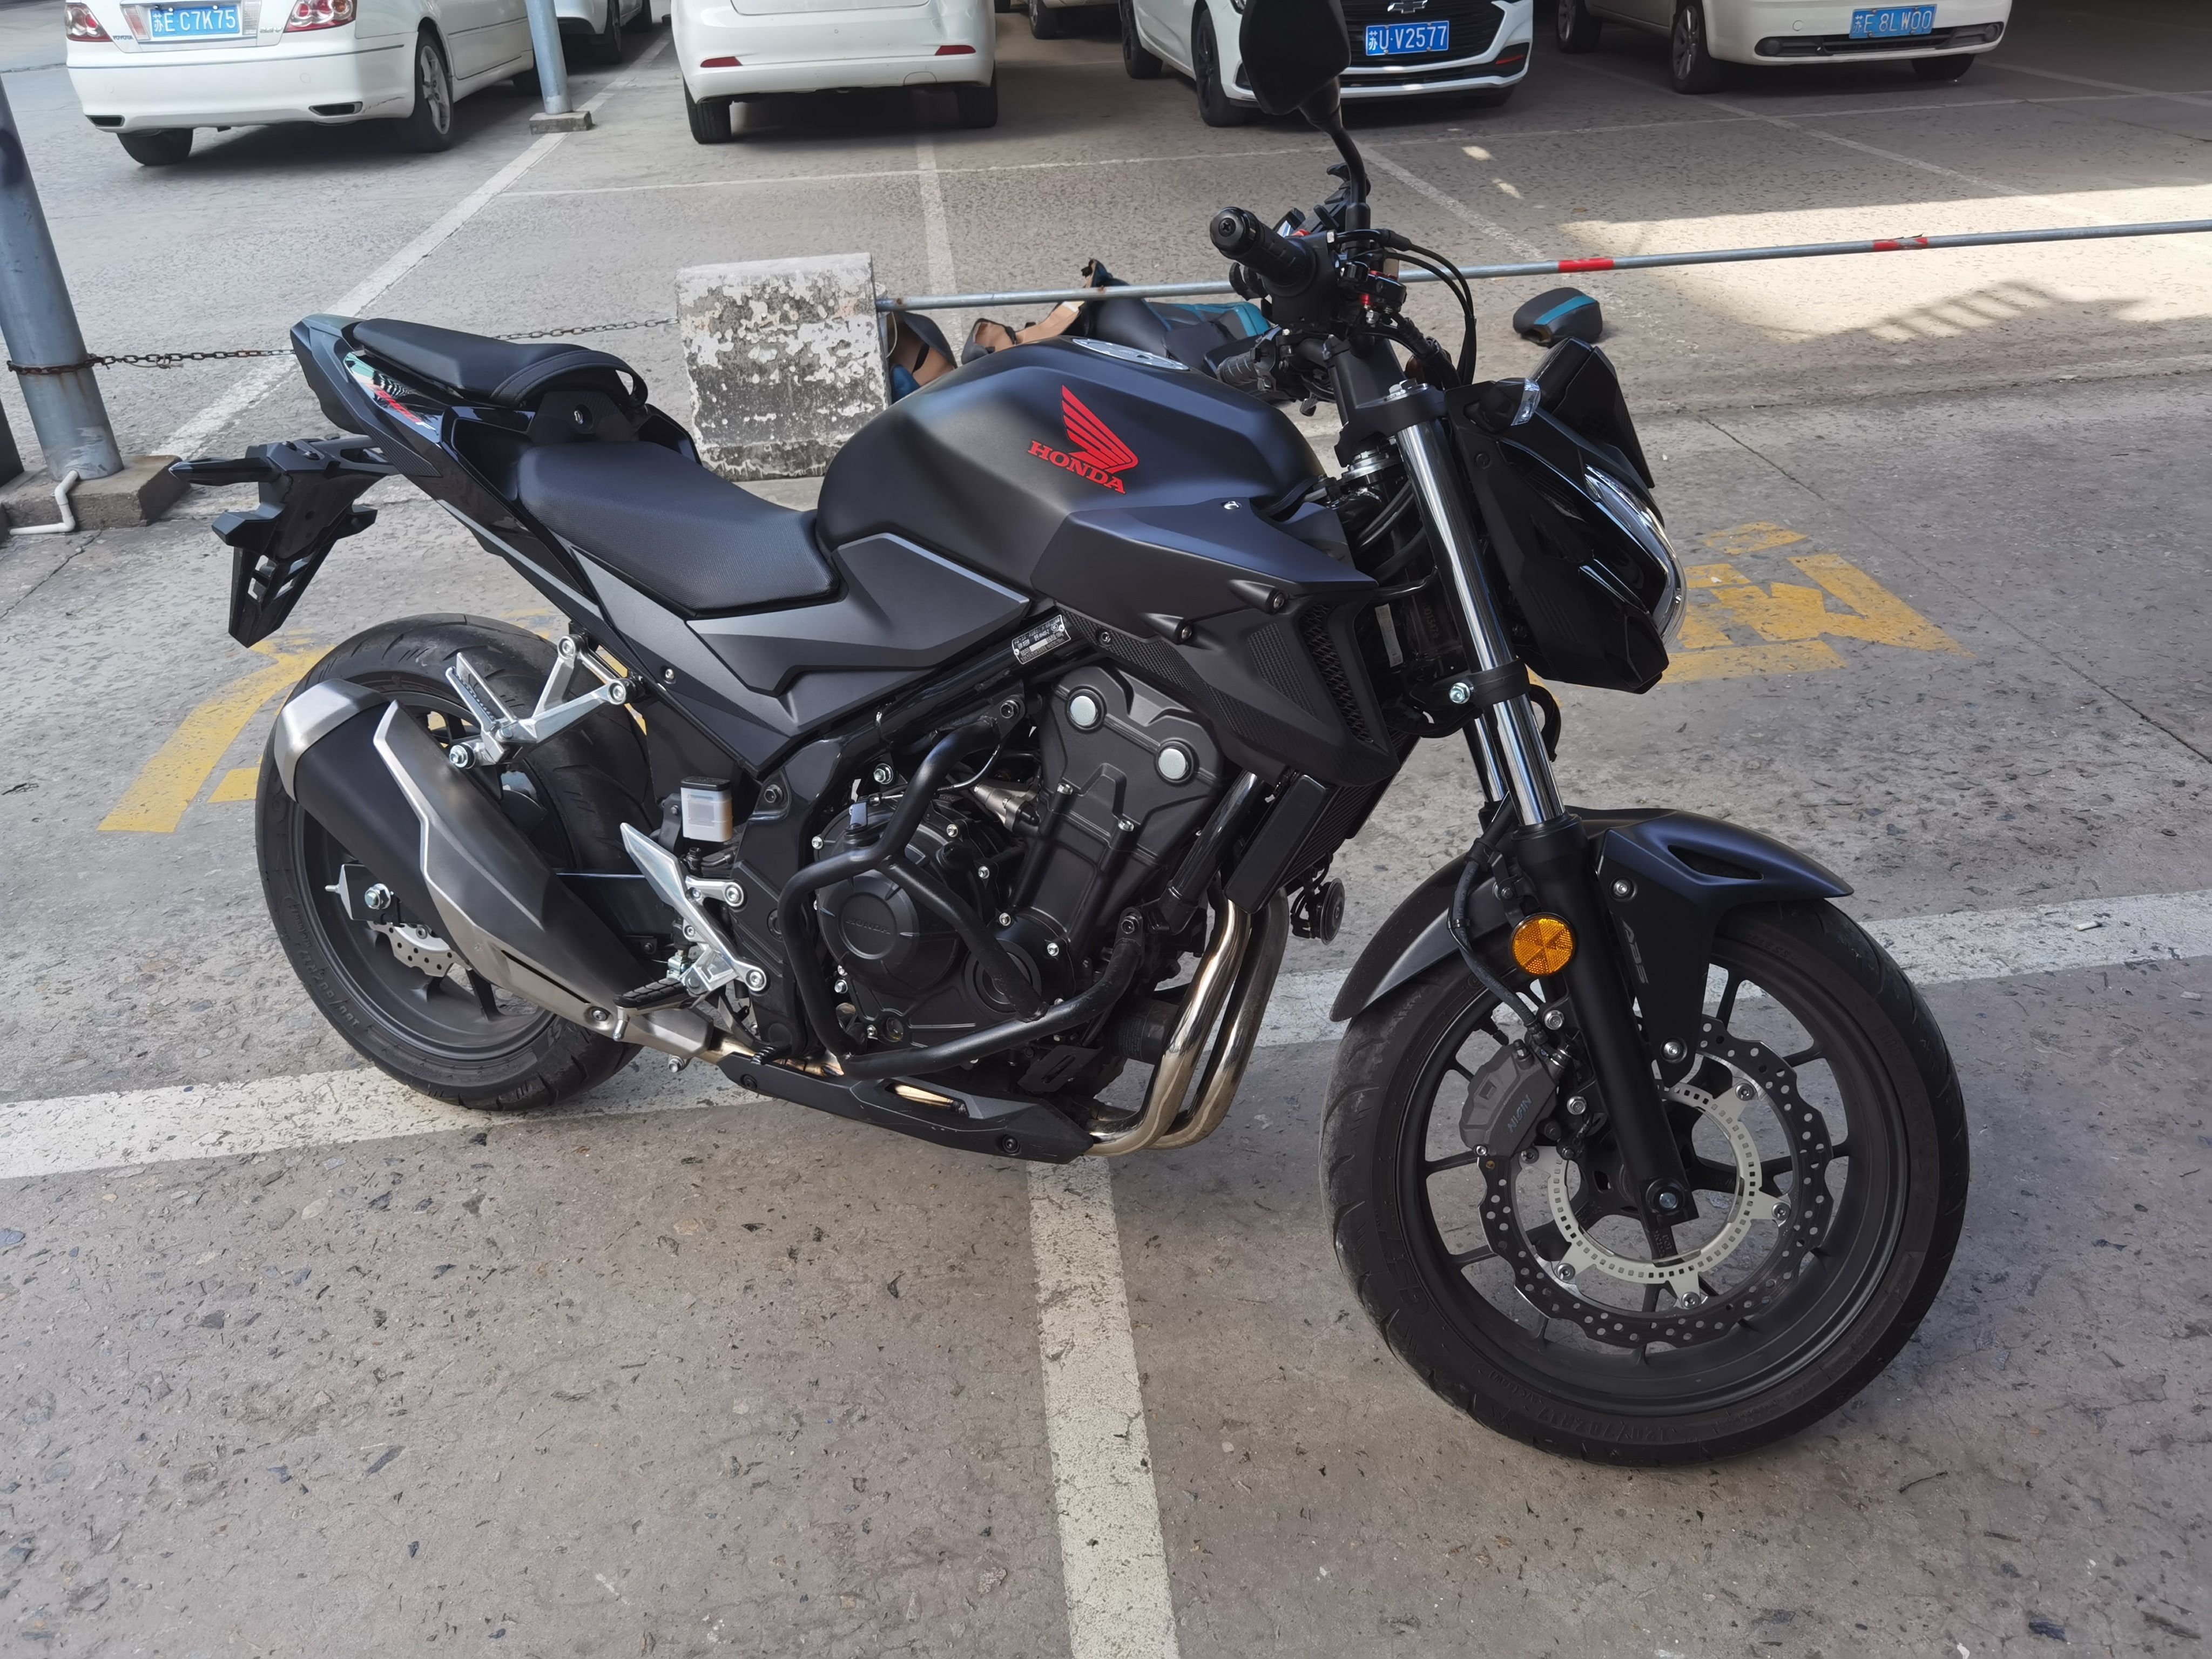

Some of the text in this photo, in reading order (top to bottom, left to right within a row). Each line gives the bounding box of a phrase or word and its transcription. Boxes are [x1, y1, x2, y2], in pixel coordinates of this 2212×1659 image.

[1028, 440, 1126, 494] HONDA
[845, 919, 891, 935] HONDA
[1621, 919, 1649, 983] ABS
